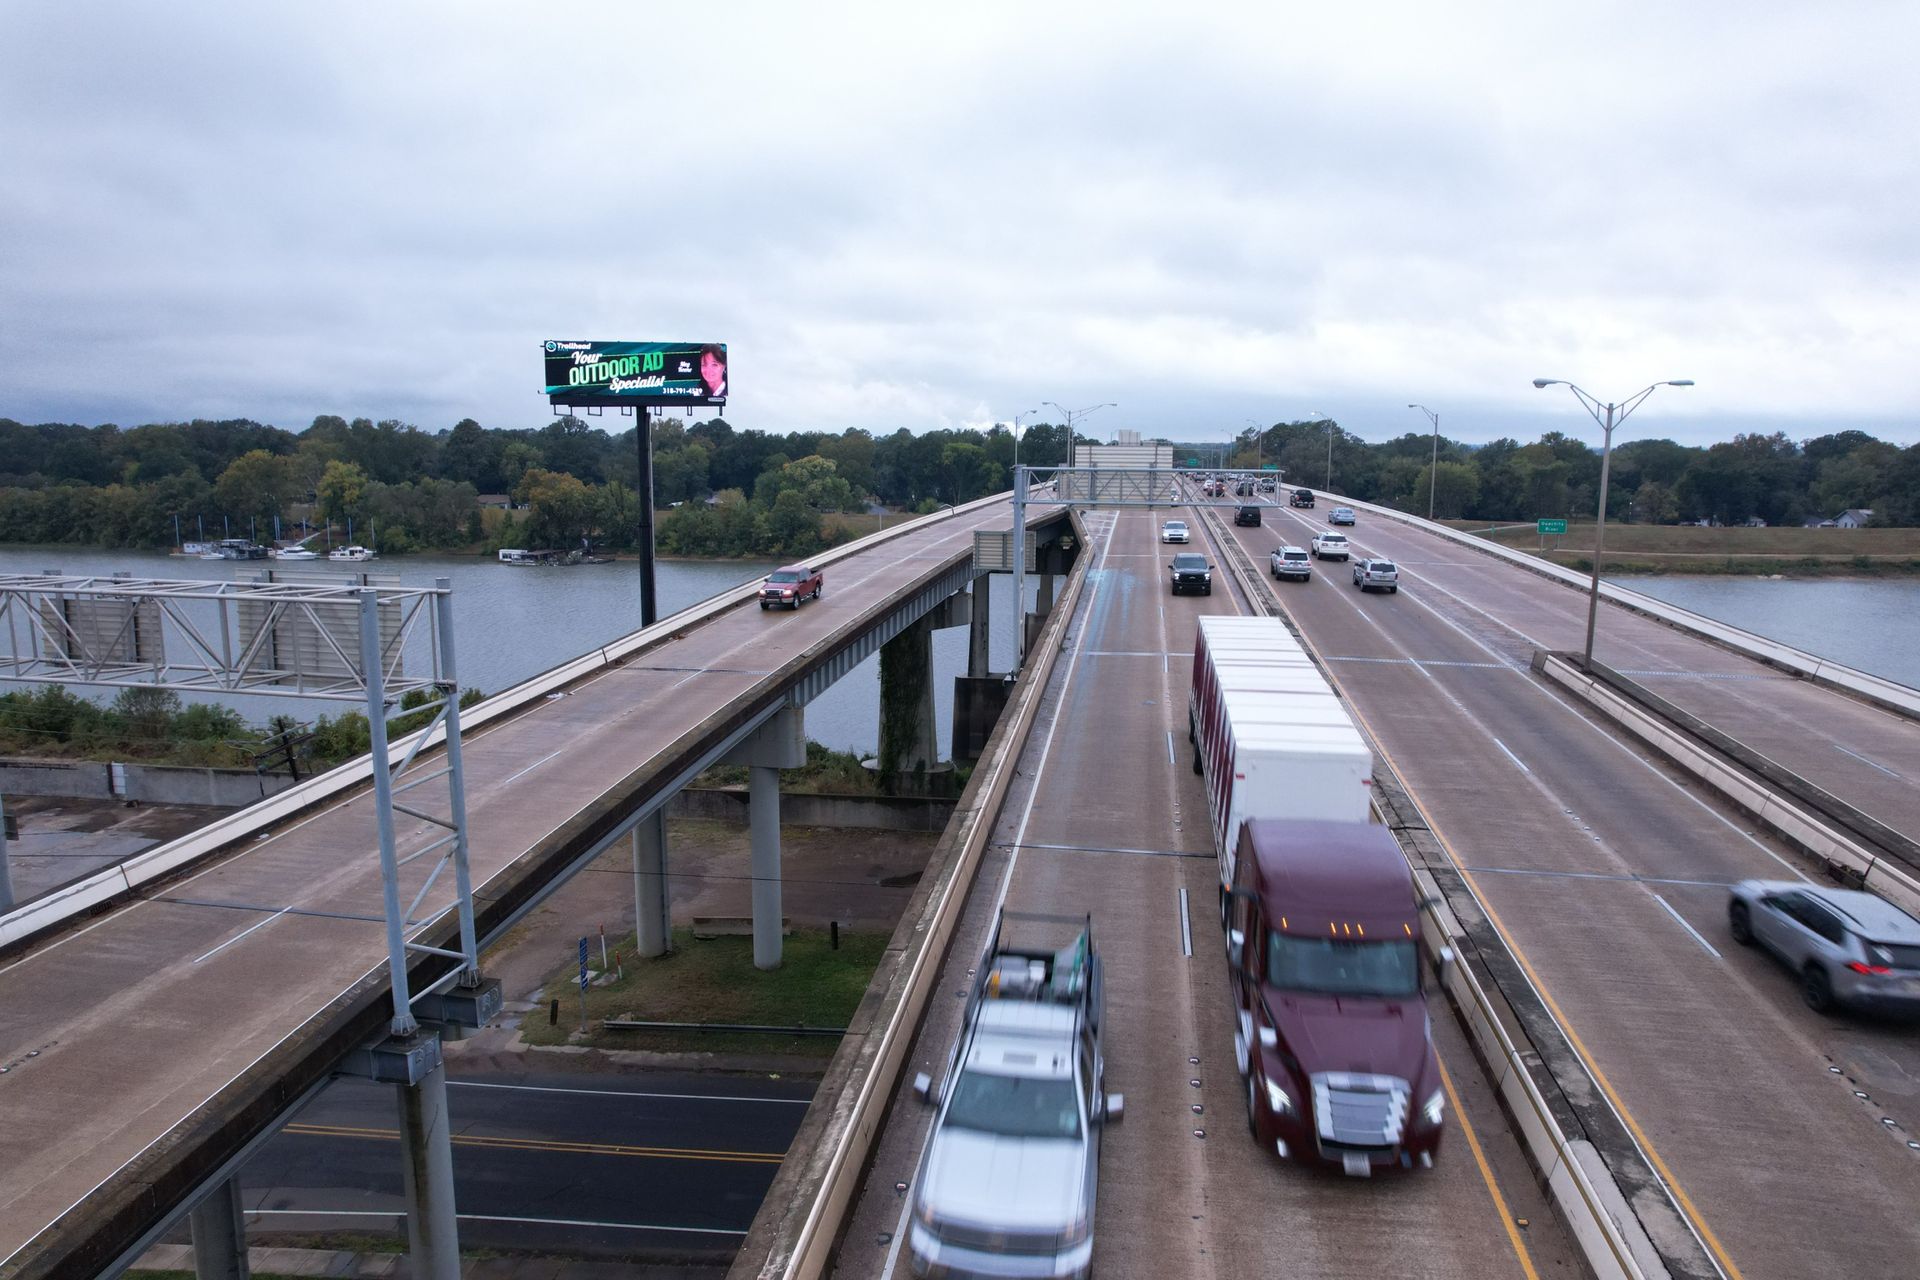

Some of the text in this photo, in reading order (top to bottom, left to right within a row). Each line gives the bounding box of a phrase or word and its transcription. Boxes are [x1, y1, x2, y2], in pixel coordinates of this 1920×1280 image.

[571, 351, 603, 364] Your
[569, 351, 664, 386] OUTDOOR AD
[609, 375, 666, 393] Specialist
